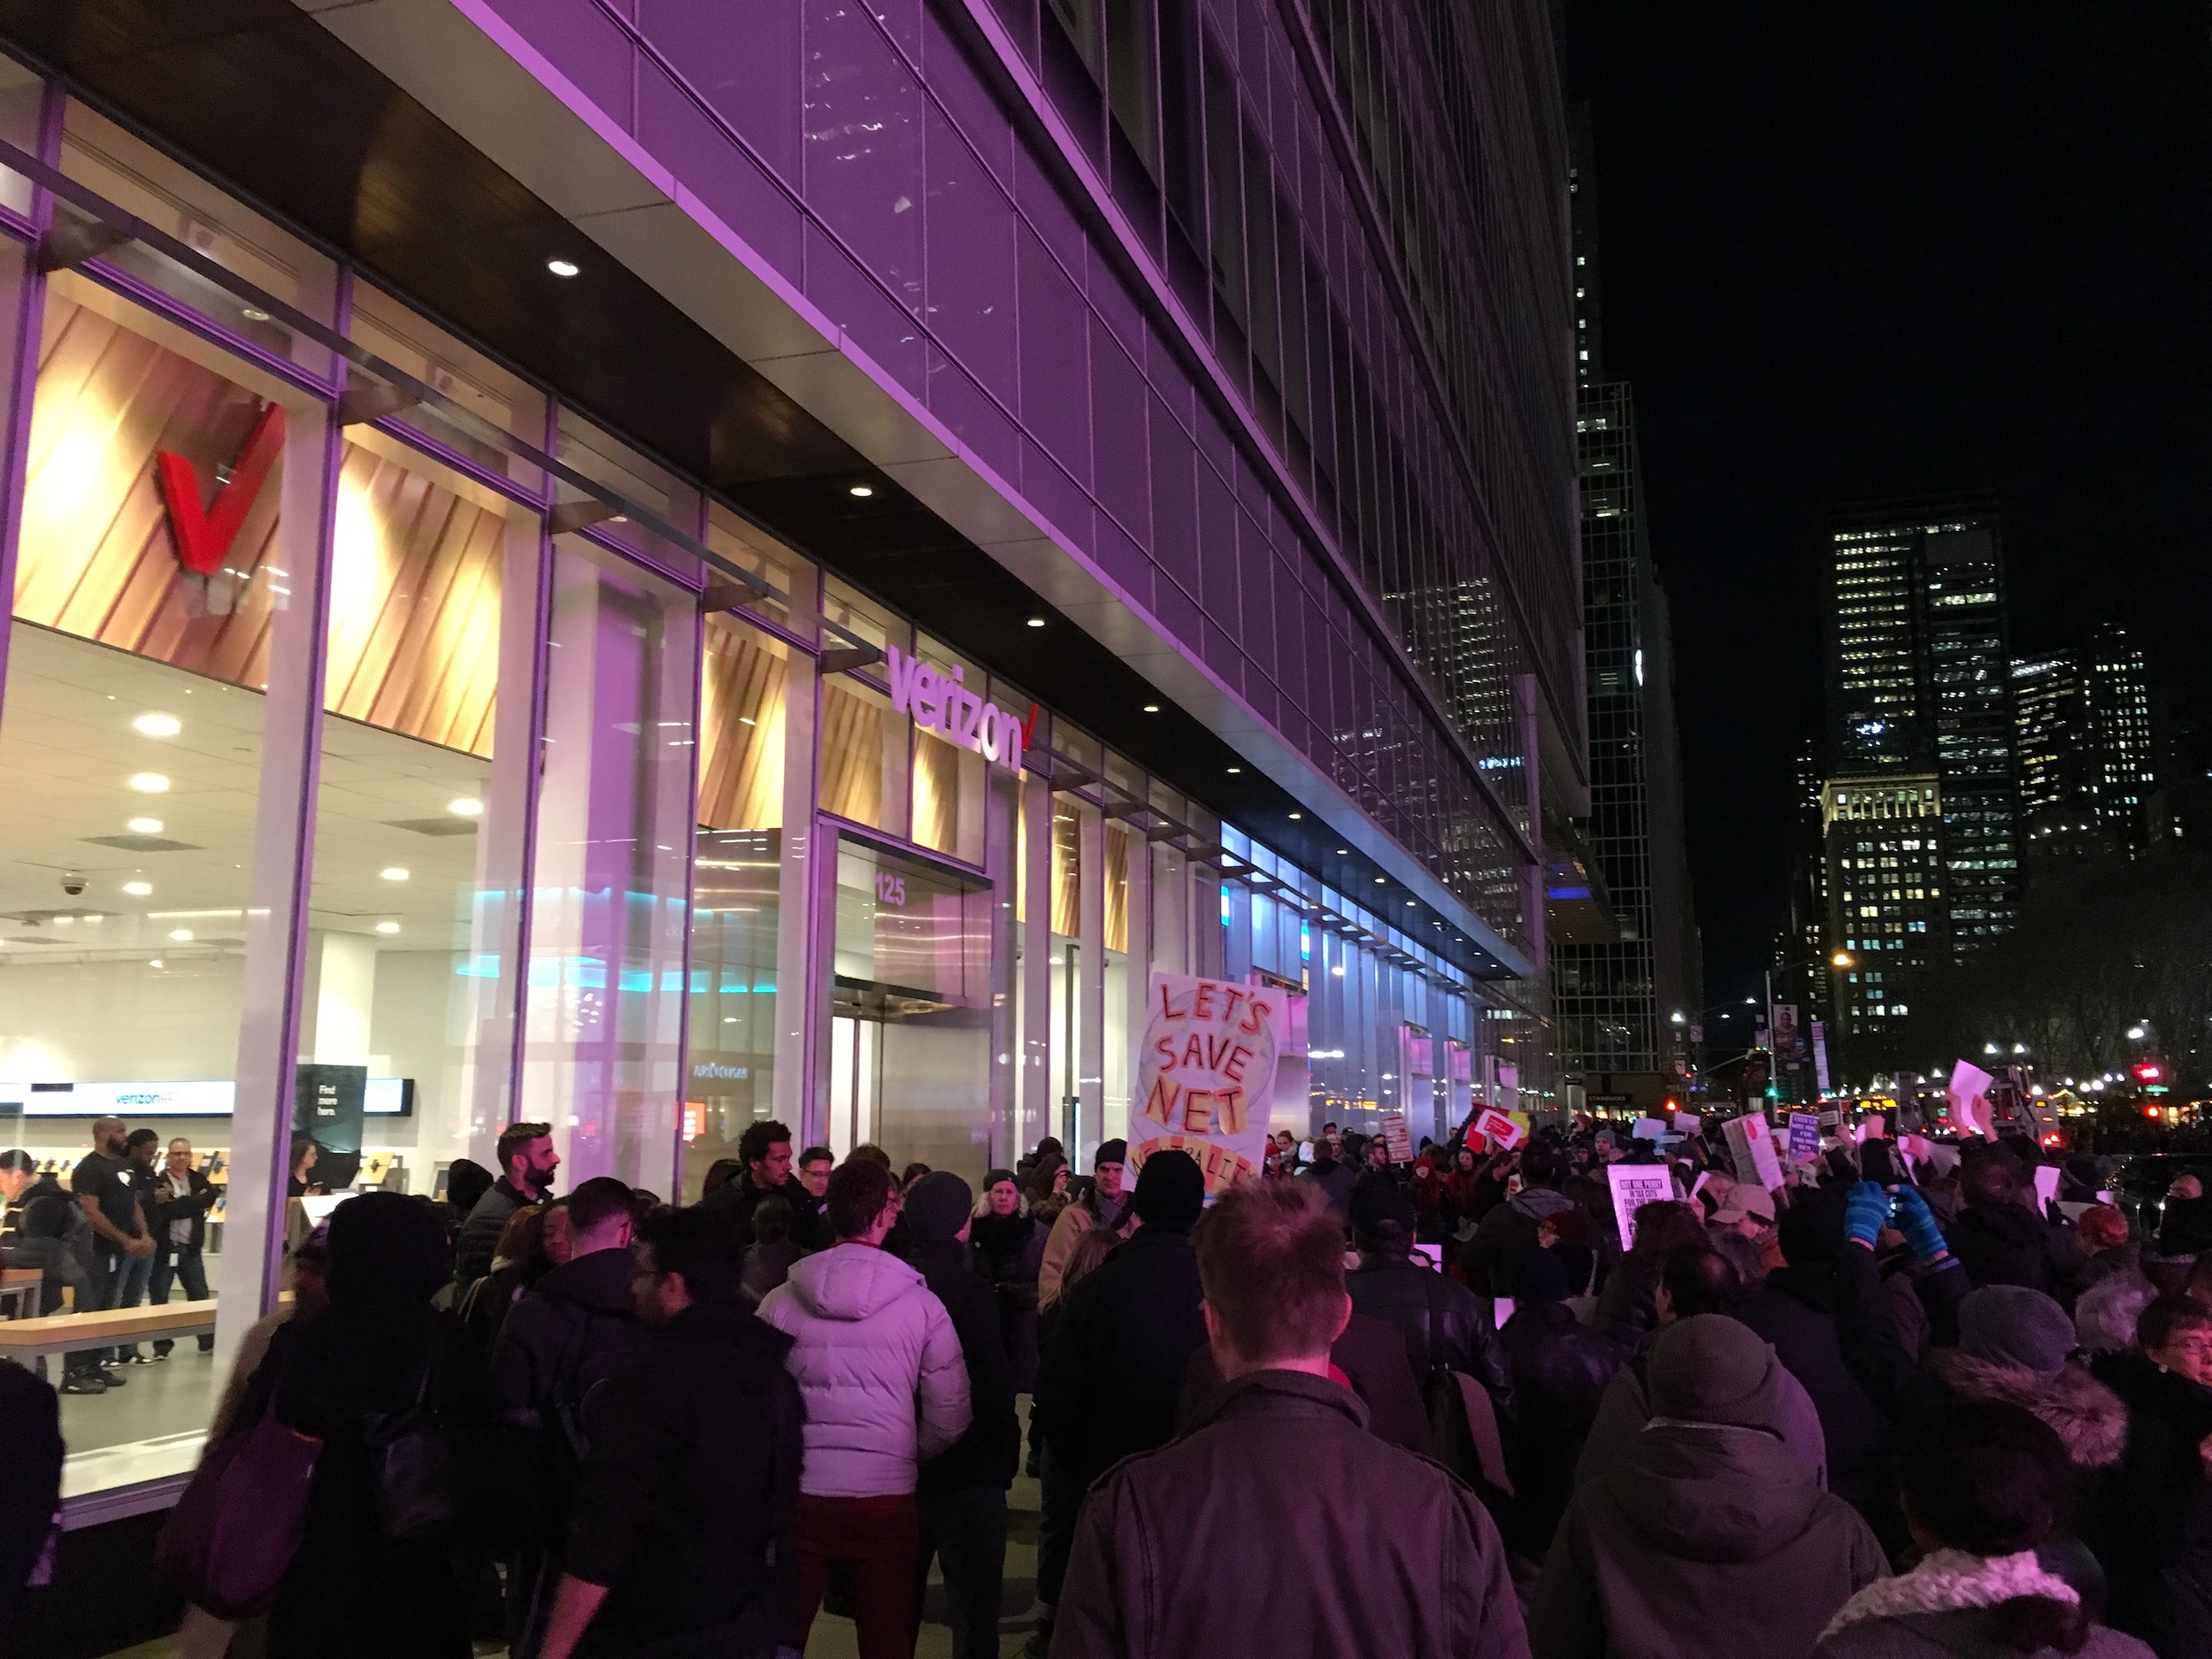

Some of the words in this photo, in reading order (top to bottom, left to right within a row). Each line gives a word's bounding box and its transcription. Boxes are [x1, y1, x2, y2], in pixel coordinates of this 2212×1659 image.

[887, 644, 1022, 773] verizon
[874, 872, 906, 906] 125
[1161, 982, 1271, 1035] LET'S
[1156, 1033, 1255, 1082] SAVE
[319, 1085, 336, 1094] Find
[1144, 1075, 1246, 1134] NET
